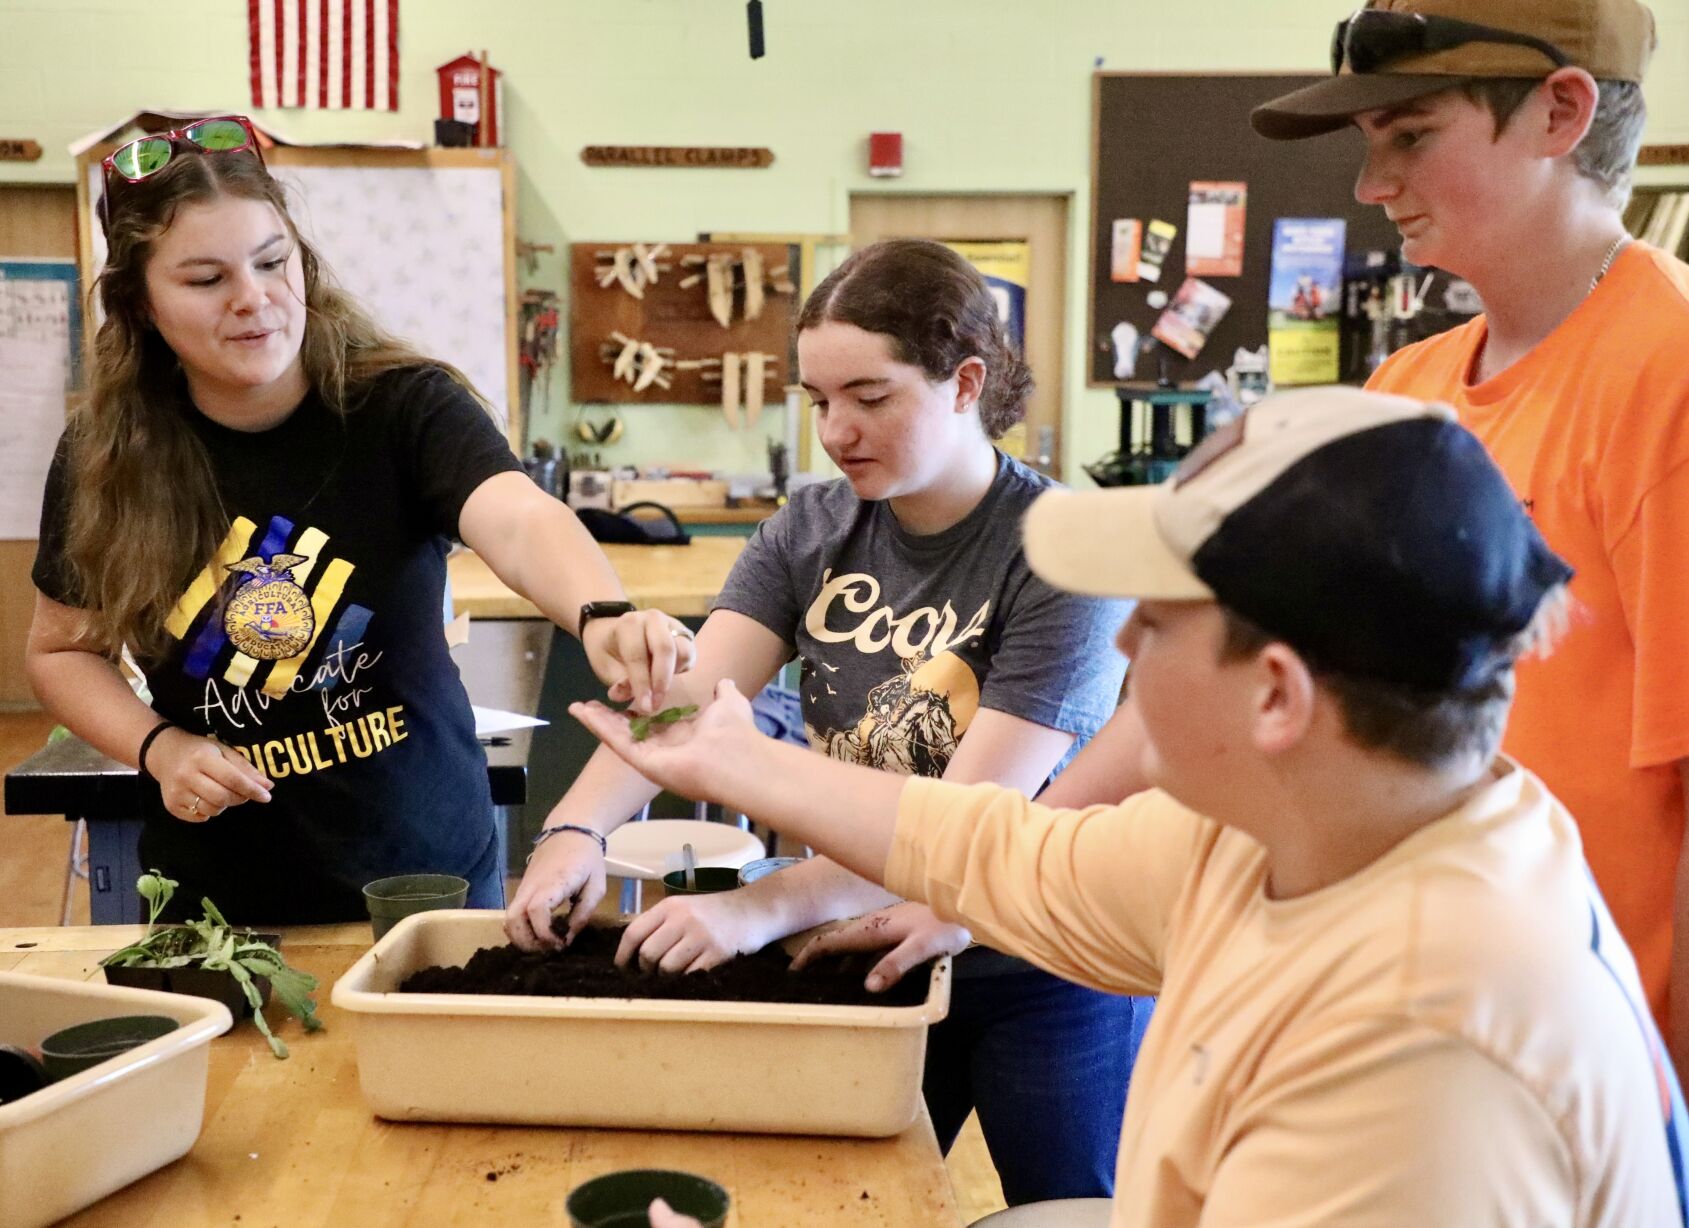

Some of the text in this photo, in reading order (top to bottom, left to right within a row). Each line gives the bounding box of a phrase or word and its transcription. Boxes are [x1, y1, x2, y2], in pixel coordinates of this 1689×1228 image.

[585, 146, 761, 167] PARALLEL CLAMPS
[238, 590, 300, 617] AGRICULTURAL
[254, 600, 288, 615] FFA
[805, 567, 991, 658] Coors
[193, 639, 384, 729] Advcate
[320, 687, 374, 740] for
